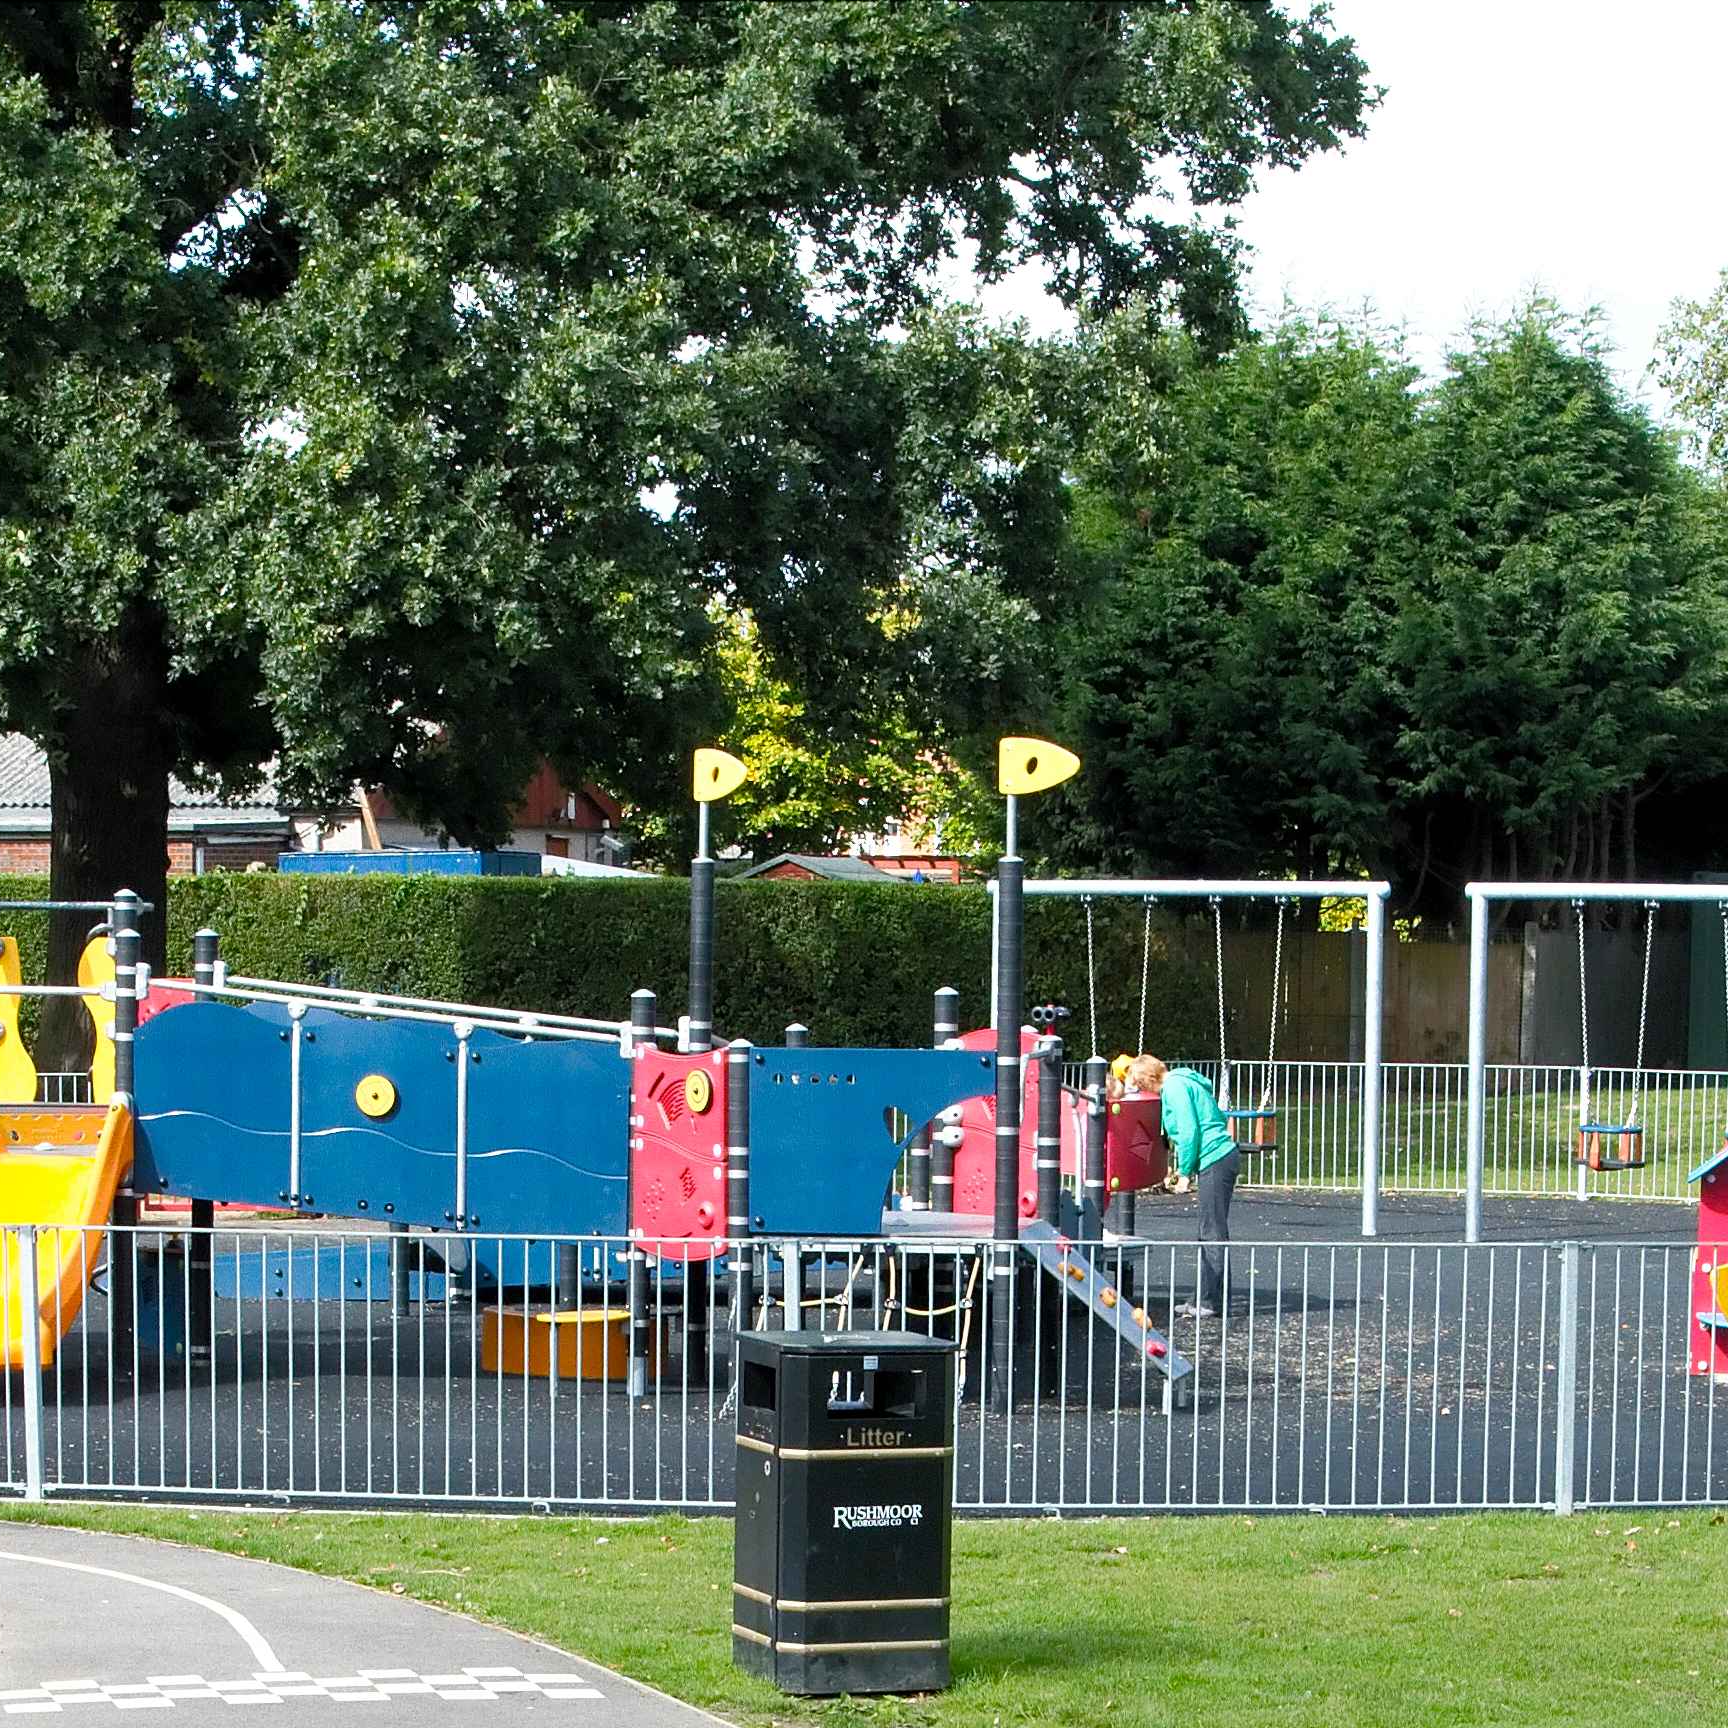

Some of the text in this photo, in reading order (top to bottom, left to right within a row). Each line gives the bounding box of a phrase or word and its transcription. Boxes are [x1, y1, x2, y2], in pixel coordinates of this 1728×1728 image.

[847, 1427, 905, 1446] Litter
[833, 1504, 924, 1529] RUSHMOOR
[852, 1518, 890, 1528] BOROUGH
